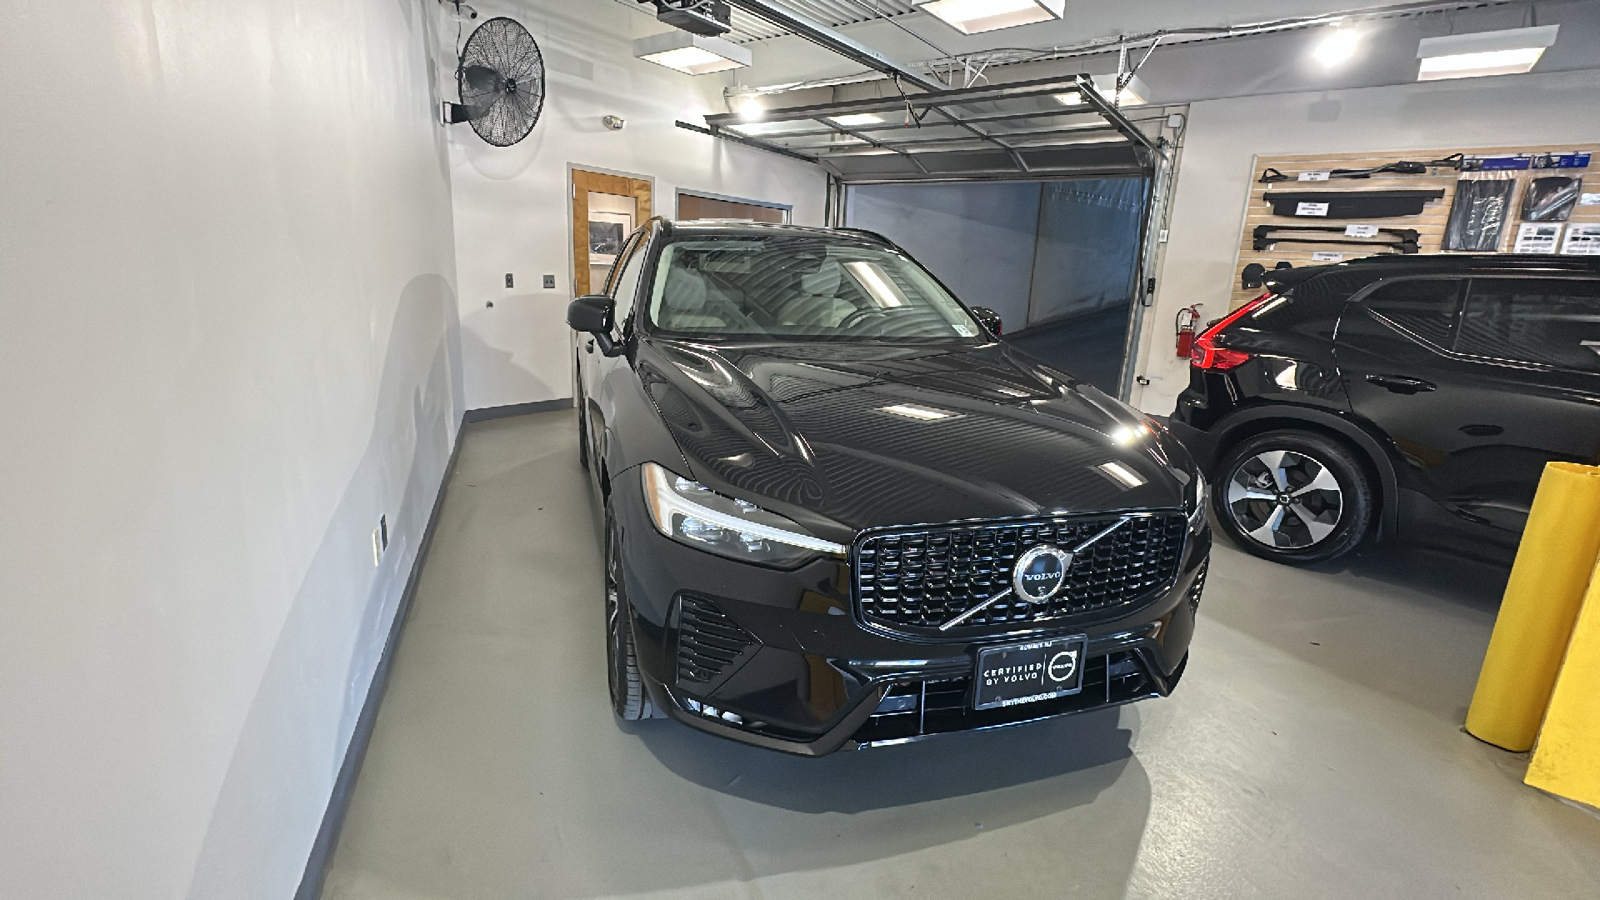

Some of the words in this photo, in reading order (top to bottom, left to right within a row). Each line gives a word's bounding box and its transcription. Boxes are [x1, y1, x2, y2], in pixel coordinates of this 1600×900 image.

[1024, 571, 1061, 581] VOLVO
[983, 662, 1043, 678] CERTIFIED
[986, 678, 999, 686] BY
[1003, 671, 1038, 683] VOLVO
